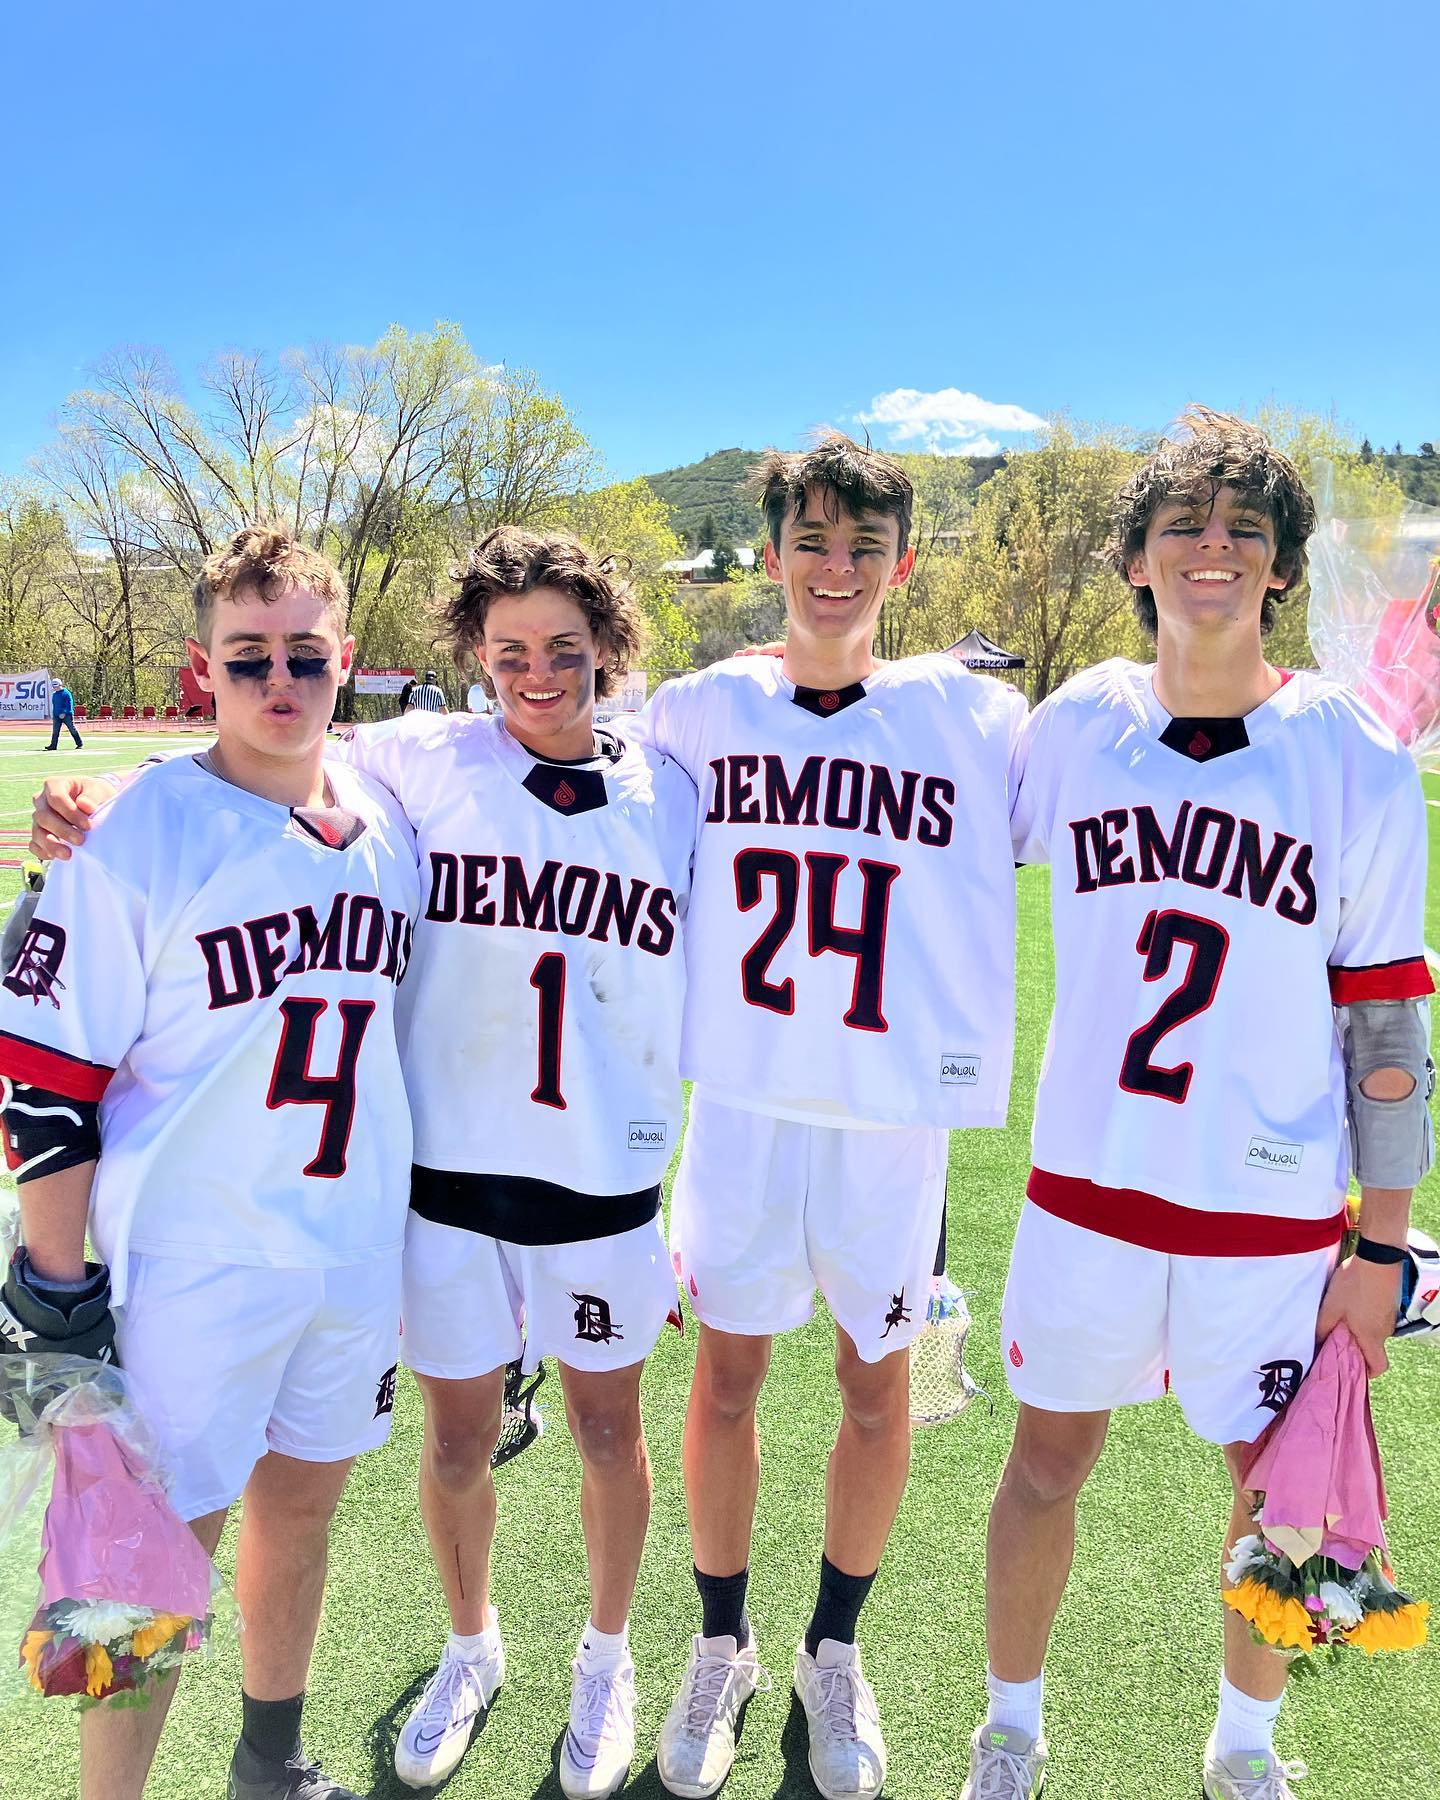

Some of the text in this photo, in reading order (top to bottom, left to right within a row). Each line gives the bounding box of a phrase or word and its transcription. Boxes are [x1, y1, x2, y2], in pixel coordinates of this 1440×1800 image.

[425, 852, 677, 956] DEMONS
[734, 847, 901, 1032] 24
[266, 997, 376, 1178] 4
[530, 952, 567, 1110] 1
[1119, 909, 1230, 1104] 2
